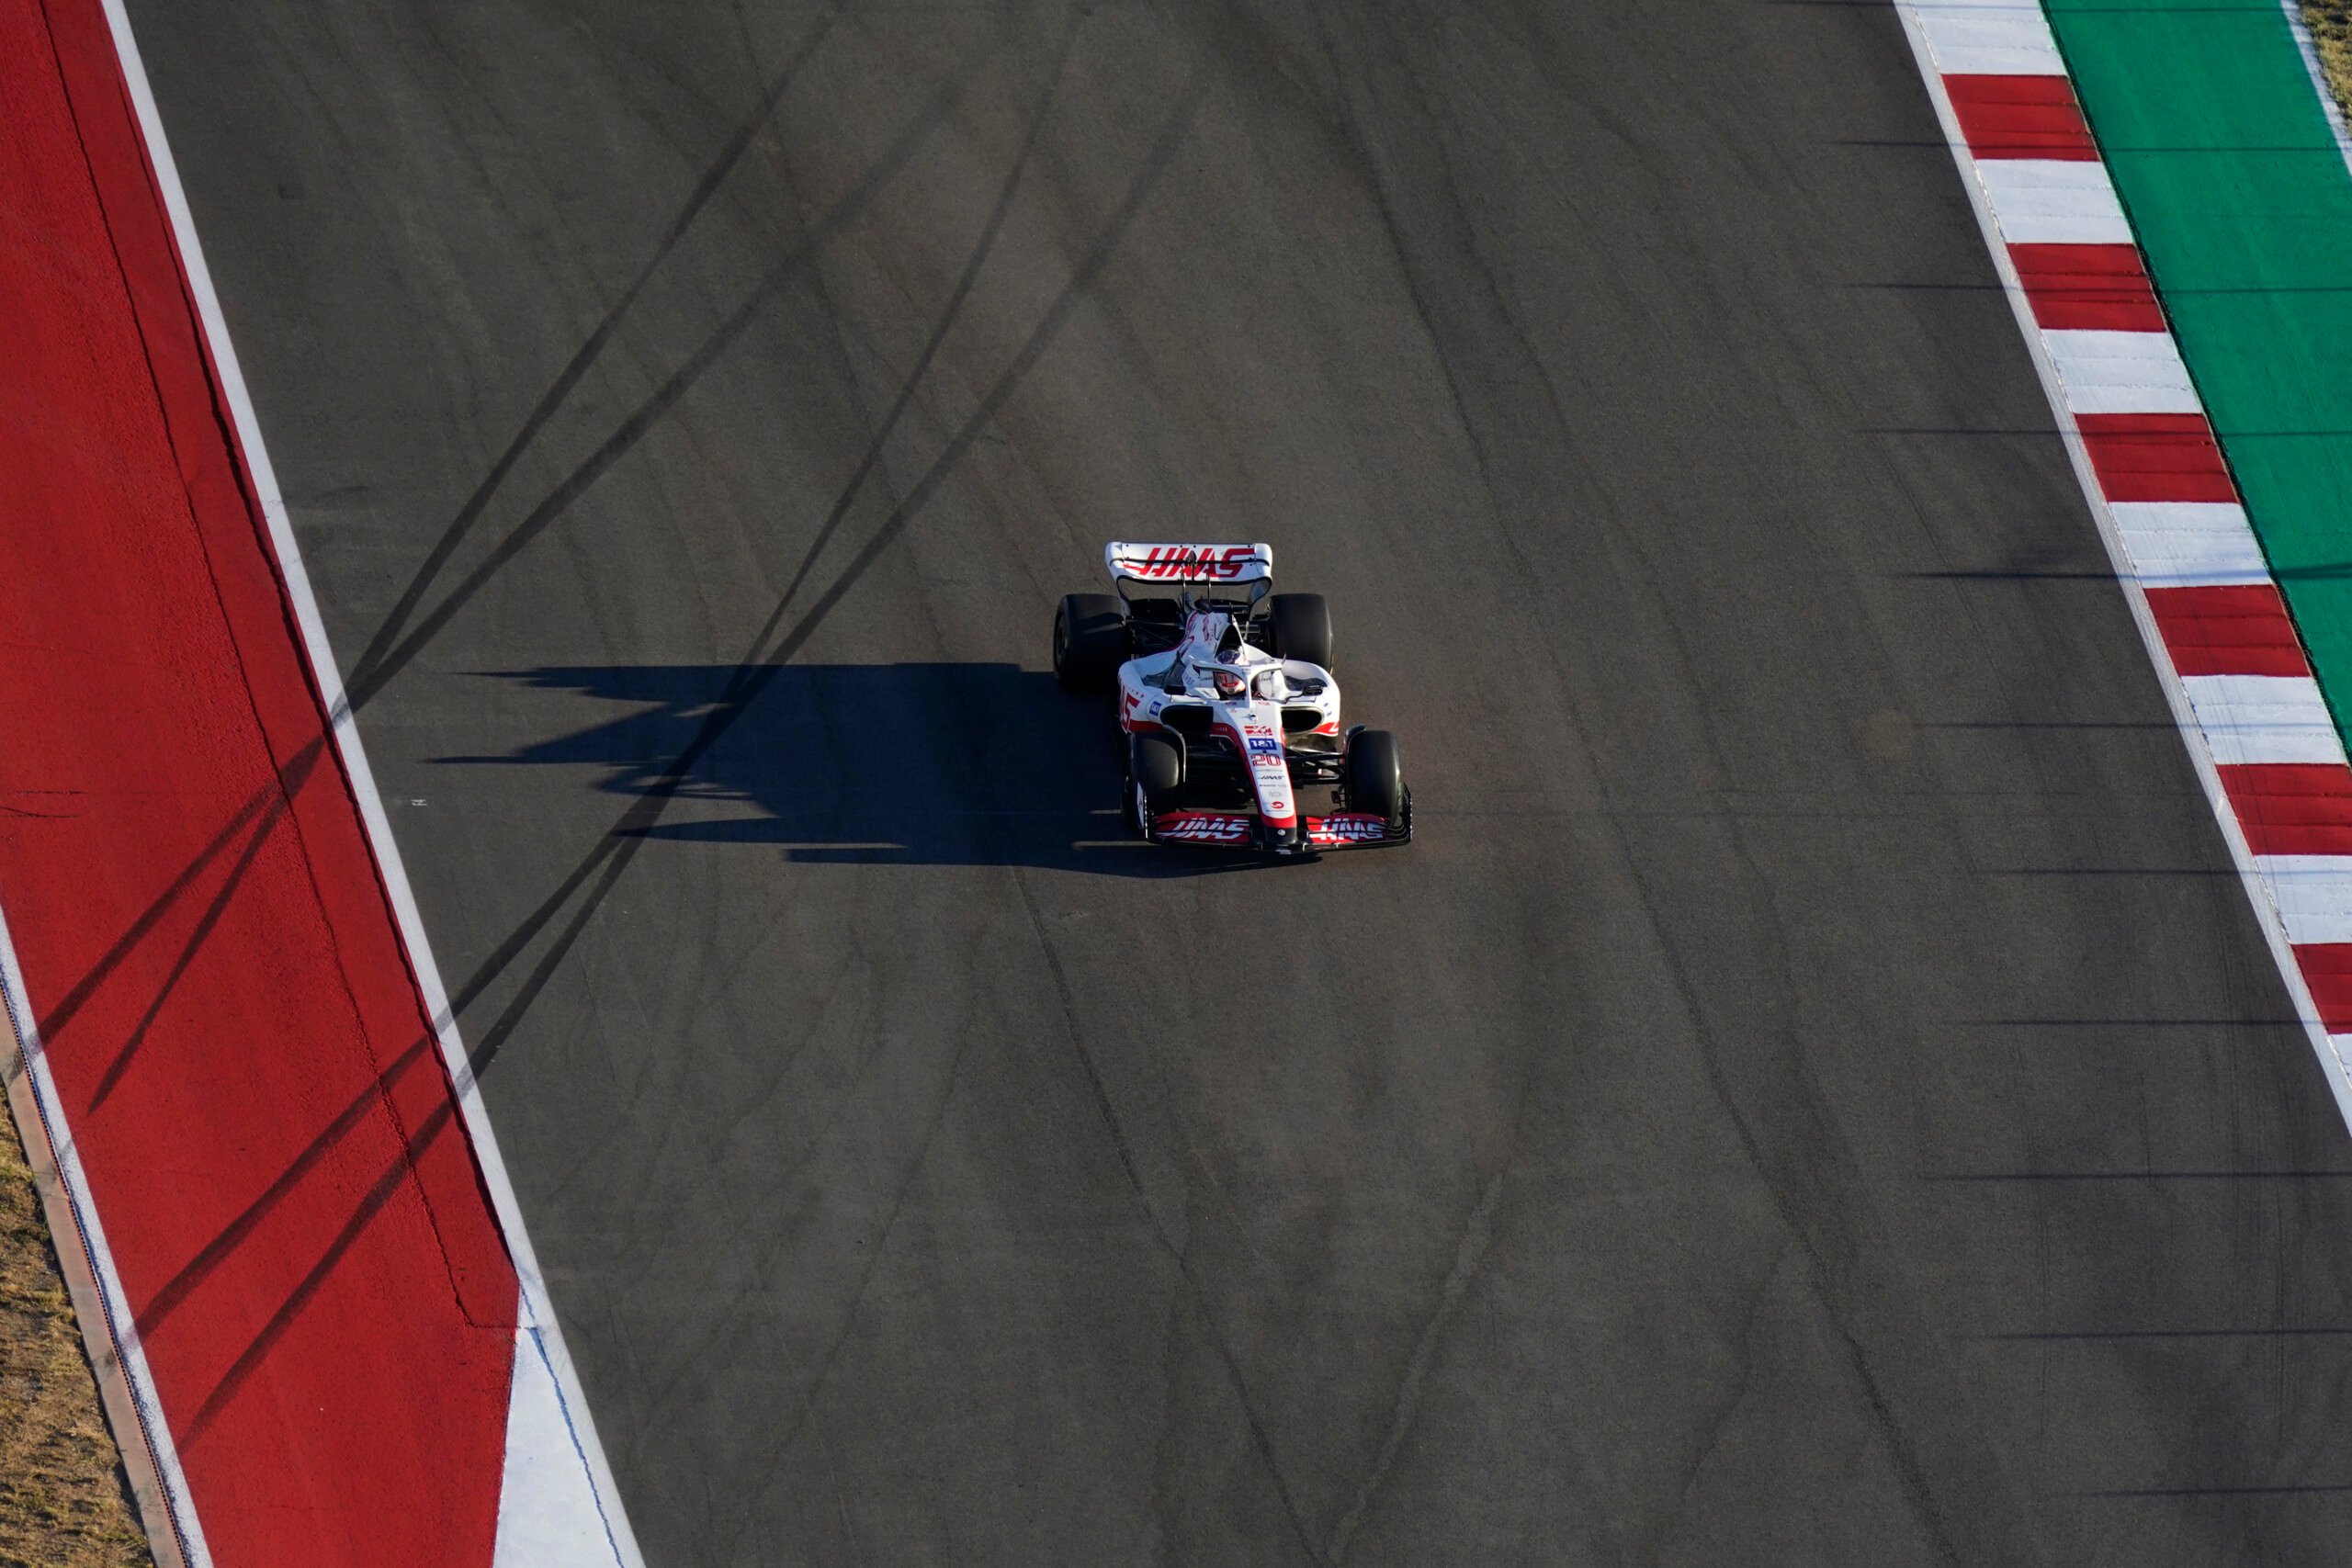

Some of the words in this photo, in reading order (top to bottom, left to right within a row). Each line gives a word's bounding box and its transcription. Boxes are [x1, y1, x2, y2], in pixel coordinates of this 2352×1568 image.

[1123, 547, 1255, 578] HAAS
[1250, 739, 1275, 748] 1&1
[1250, 753, 1282, 767] 20
[1155, 817, 1250, 840] HAAS
[1308, 818, 1386, 840] HAAS
